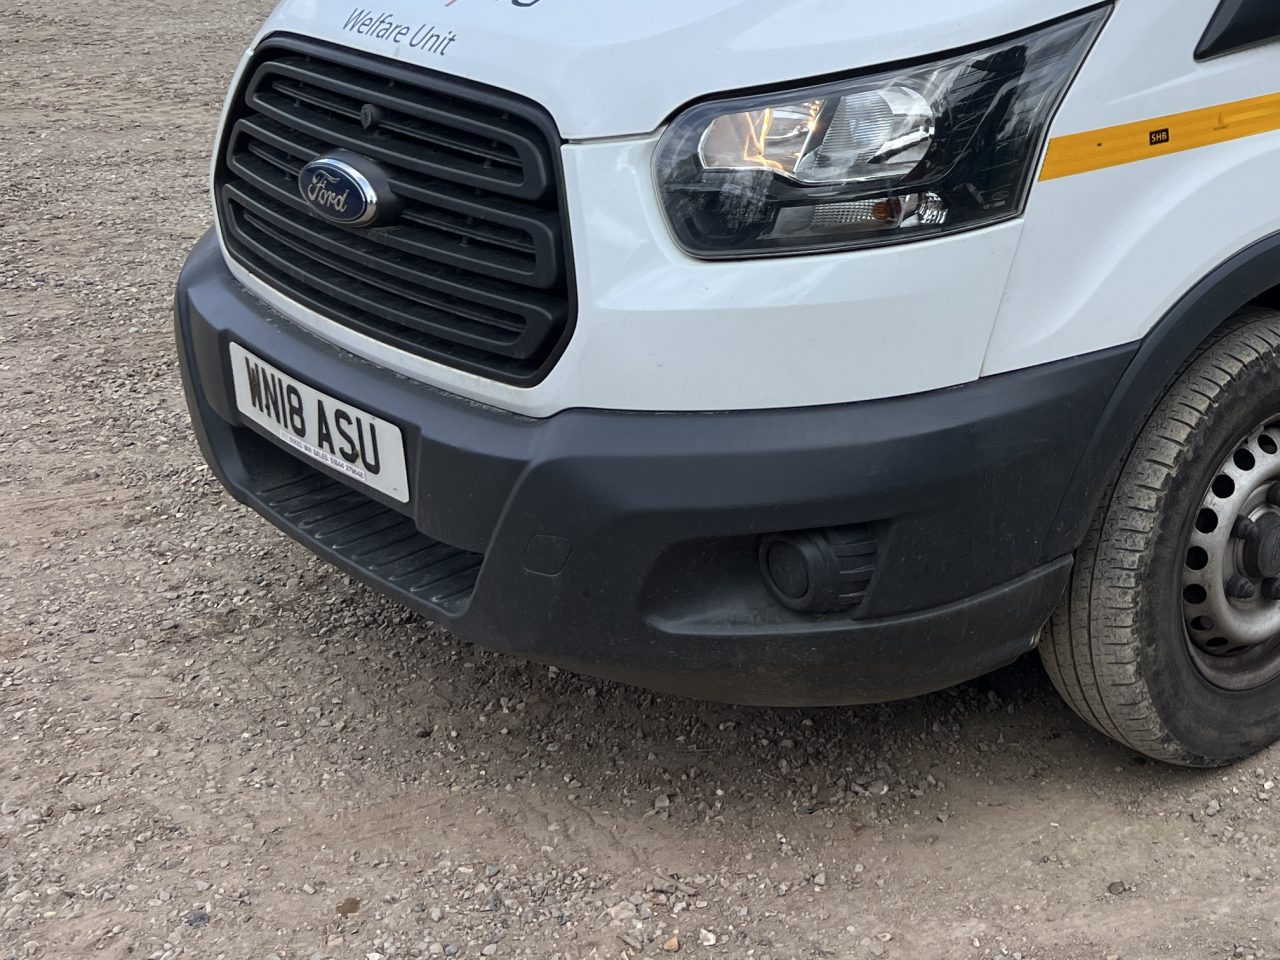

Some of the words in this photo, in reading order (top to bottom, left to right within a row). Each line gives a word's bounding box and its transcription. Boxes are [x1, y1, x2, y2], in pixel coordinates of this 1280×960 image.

[343, 8, 410, 43] Welfare
[409, 24, 457, 55] Unit
[1150, 130, 1168, 143] SHB
[308, 169, 350, 212] Ford
[244, 356, 306, 439] WN18
[317, 399, 381, 476] ASU
